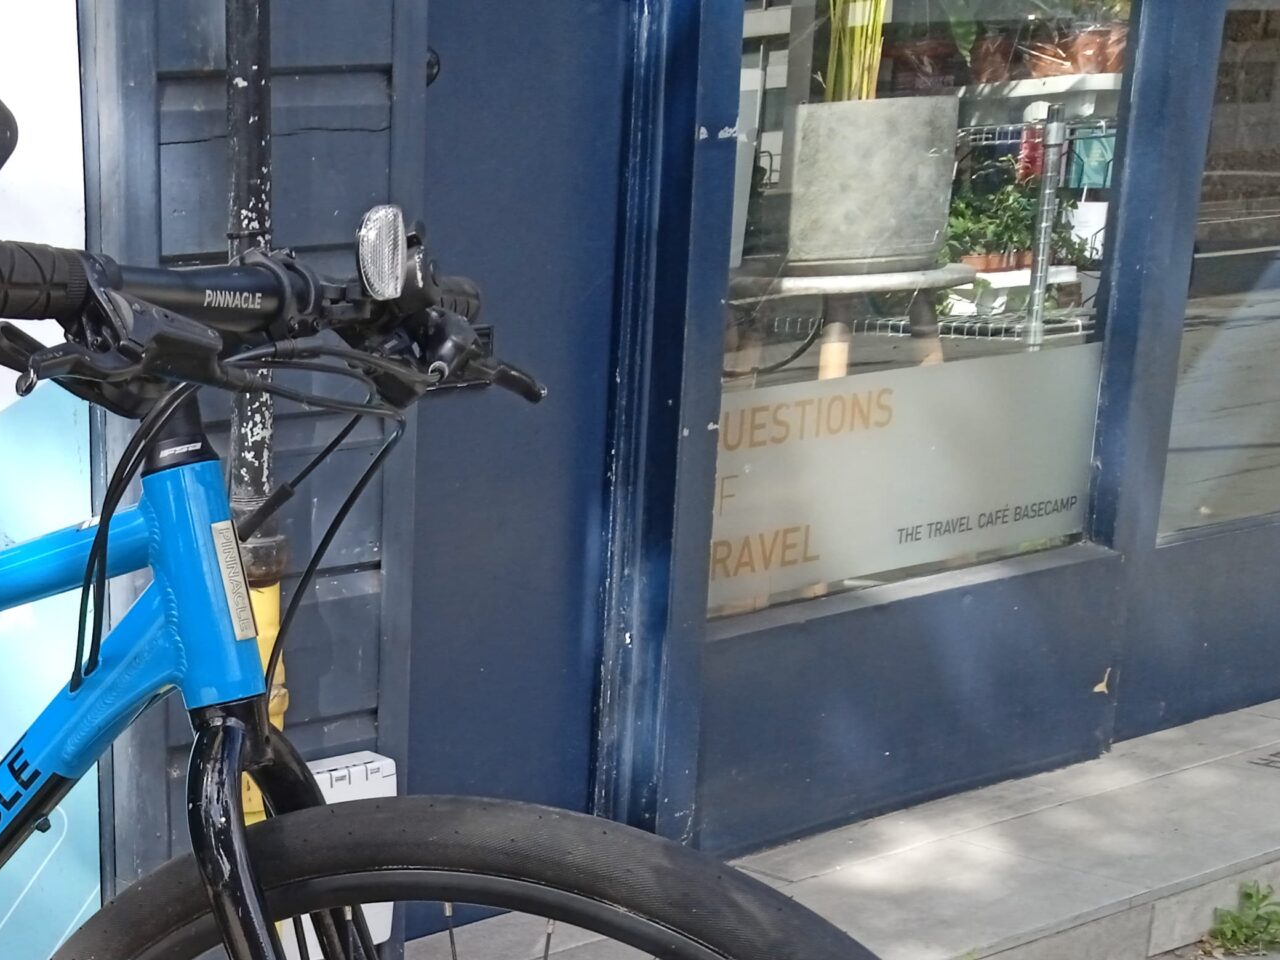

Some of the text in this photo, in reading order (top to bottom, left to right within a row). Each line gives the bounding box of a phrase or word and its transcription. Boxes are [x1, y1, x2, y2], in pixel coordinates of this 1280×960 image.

[203, 289, 263, 309] PINNACLE
[722, 387, 894, 451] UESTIONS
[719, 474, 739, 517] F
[897, 495, 1078, 544] THE TRAVEL CAFÉ BASECAMP
[710, 524, 820, 581] RAVEL
[218, 526, 250, 633] PINNACLE
